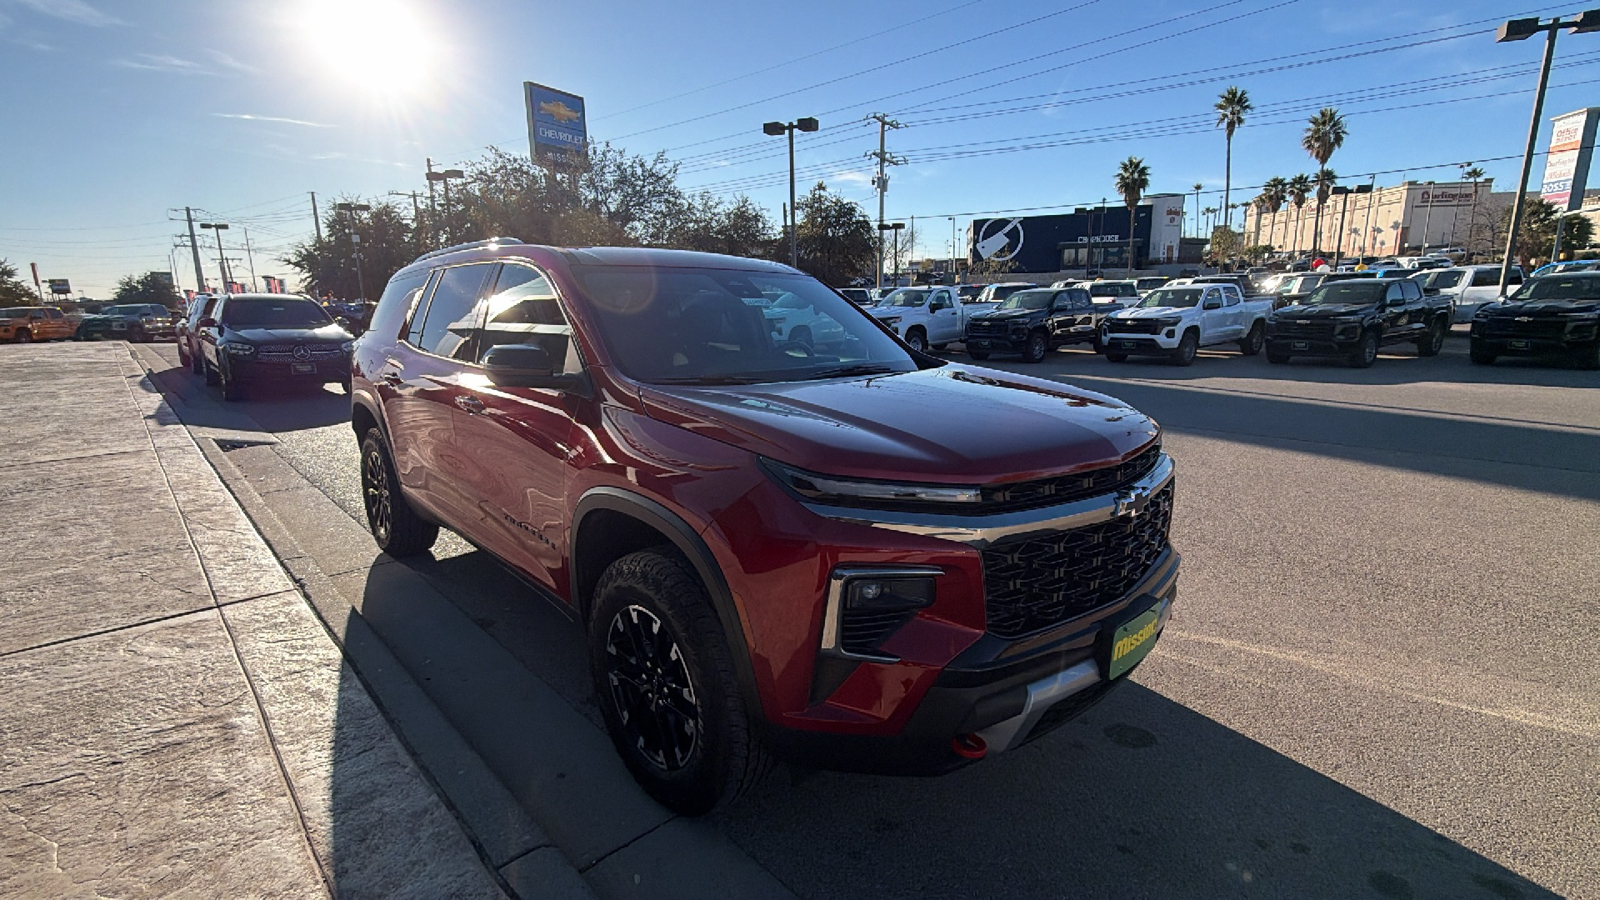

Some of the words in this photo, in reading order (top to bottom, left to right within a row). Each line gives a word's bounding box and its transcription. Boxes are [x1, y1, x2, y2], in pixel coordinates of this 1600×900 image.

[539, 127, 584, 144] CHEVROLET
[1541, 181, 1564, 194] ROSS
[1077, 234, 1120, 244] CHPHOUSE
